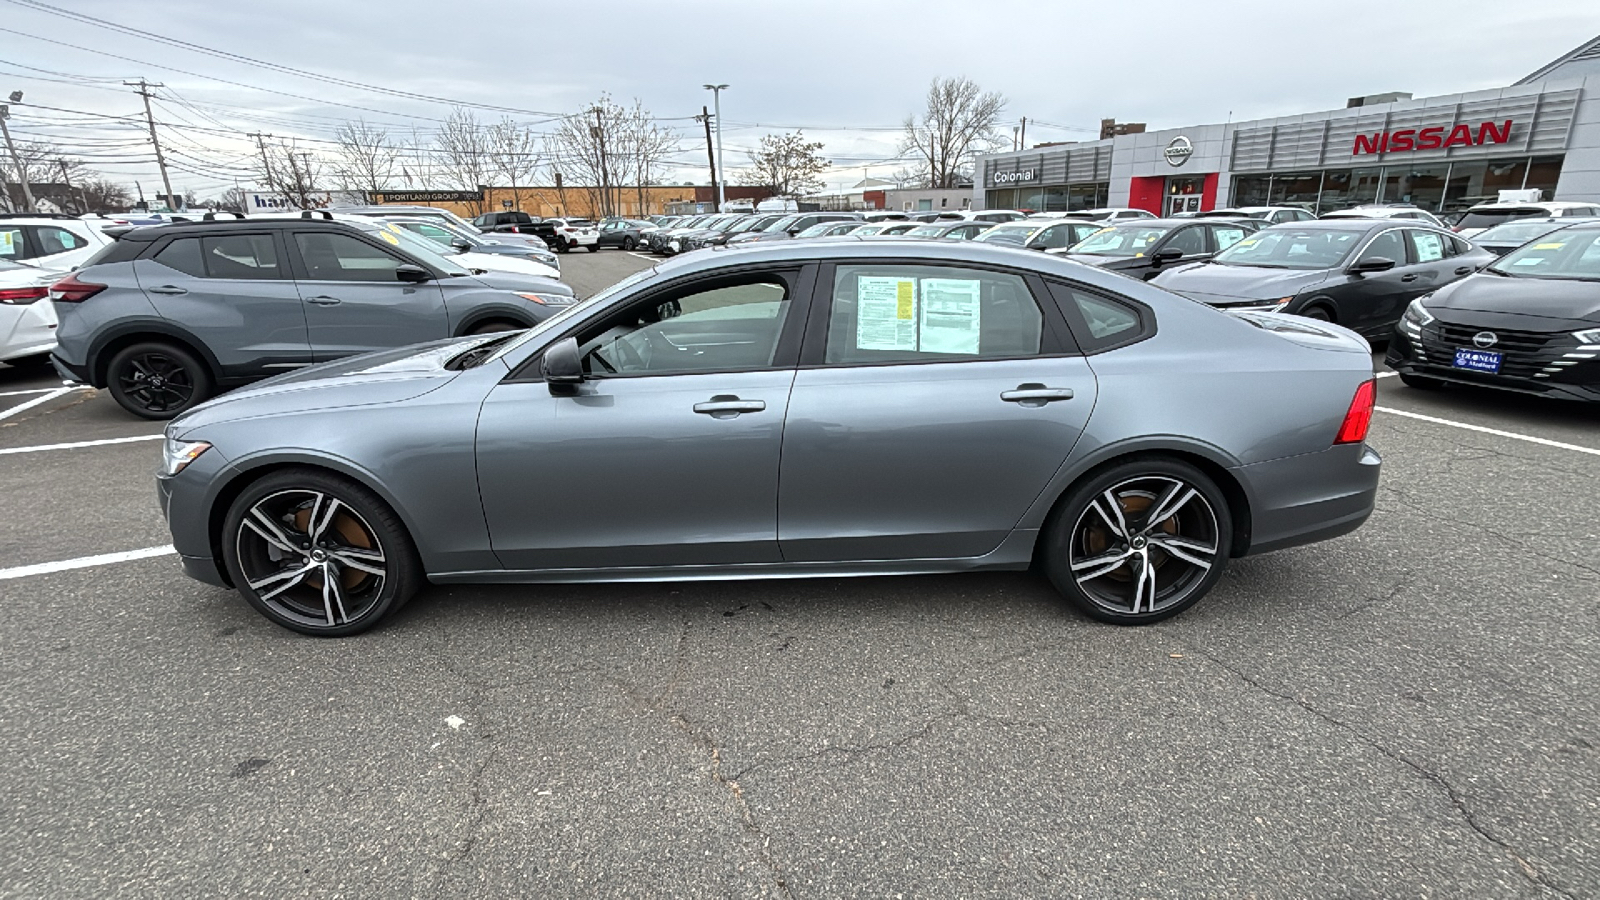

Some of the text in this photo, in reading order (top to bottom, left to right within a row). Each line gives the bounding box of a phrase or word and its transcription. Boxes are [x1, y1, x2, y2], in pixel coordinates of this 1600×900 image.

[1353, 119, 1513, 156] NISSAN
[994, 168, 1034, 183] Colonial
[389, 193, 430, 201] PORTLAND
[1469, 360, 1496, 369] Medford
